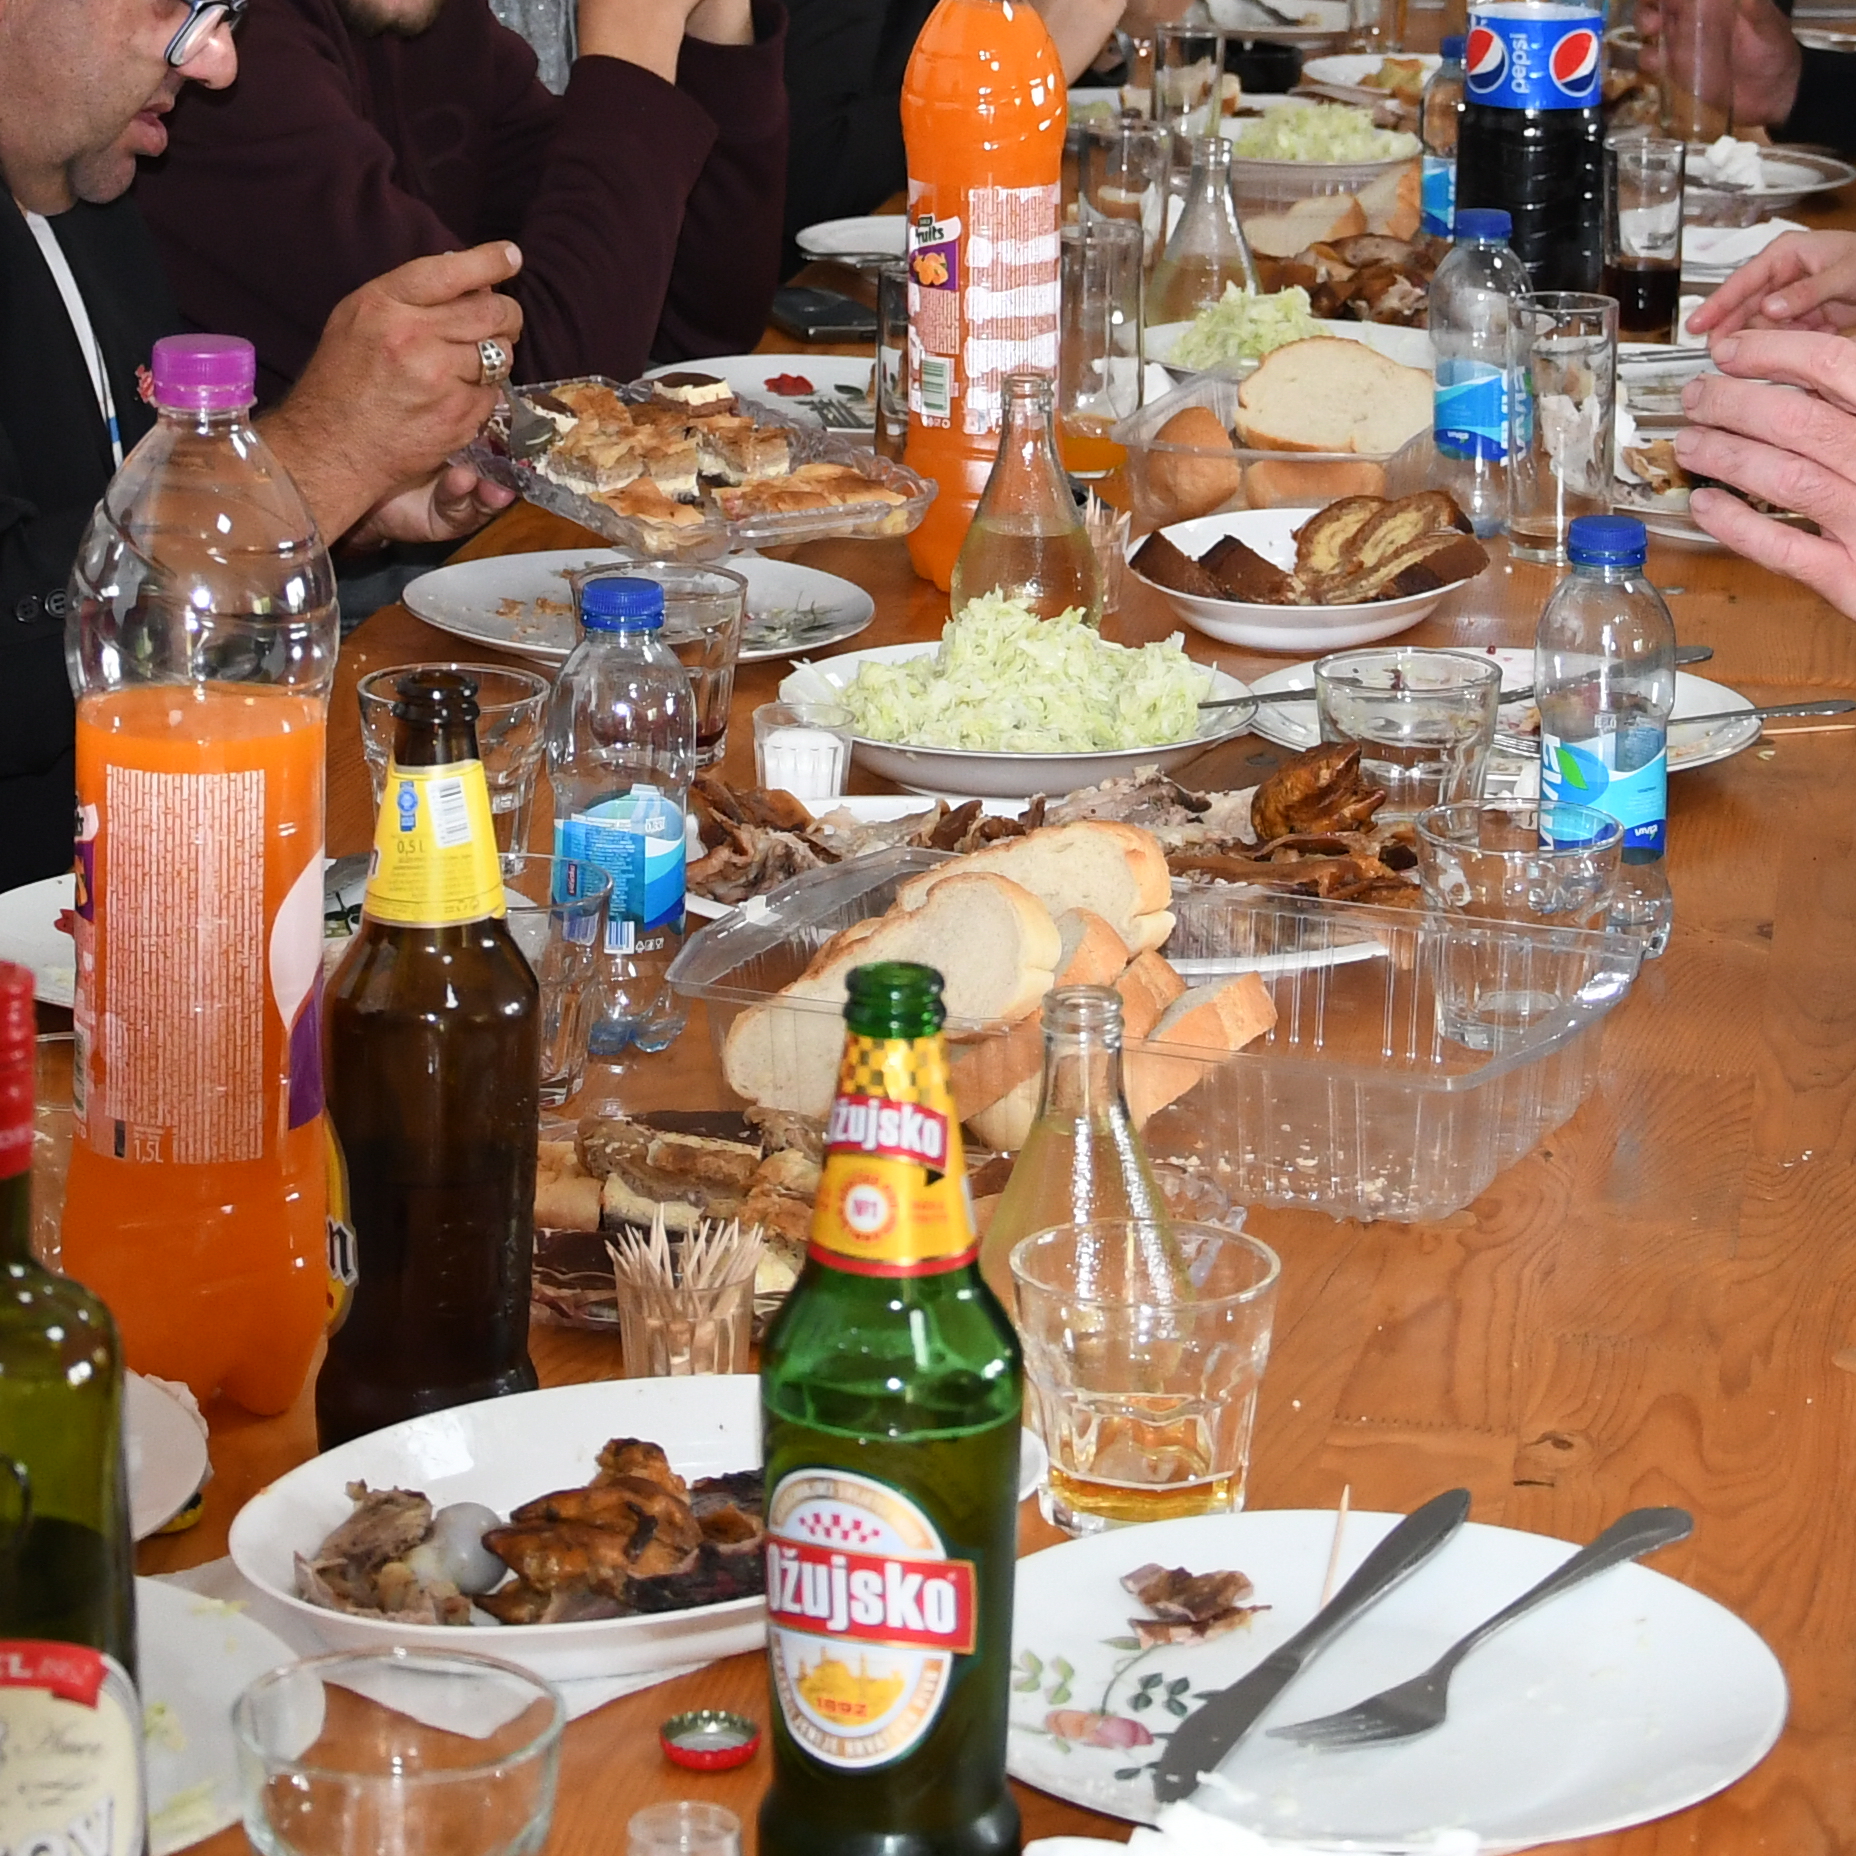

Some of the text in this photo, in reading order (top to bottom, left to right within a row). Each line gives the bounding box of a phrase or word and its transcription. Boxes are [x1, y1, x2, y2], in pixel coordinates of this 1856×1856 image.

[1509, 33, 1531, 93] pepsi
[915, 225, 945, 245] ruits
[827, 1097, 943, 1159] žujsko
[133, 1139, 164, 1164] 1,5L
